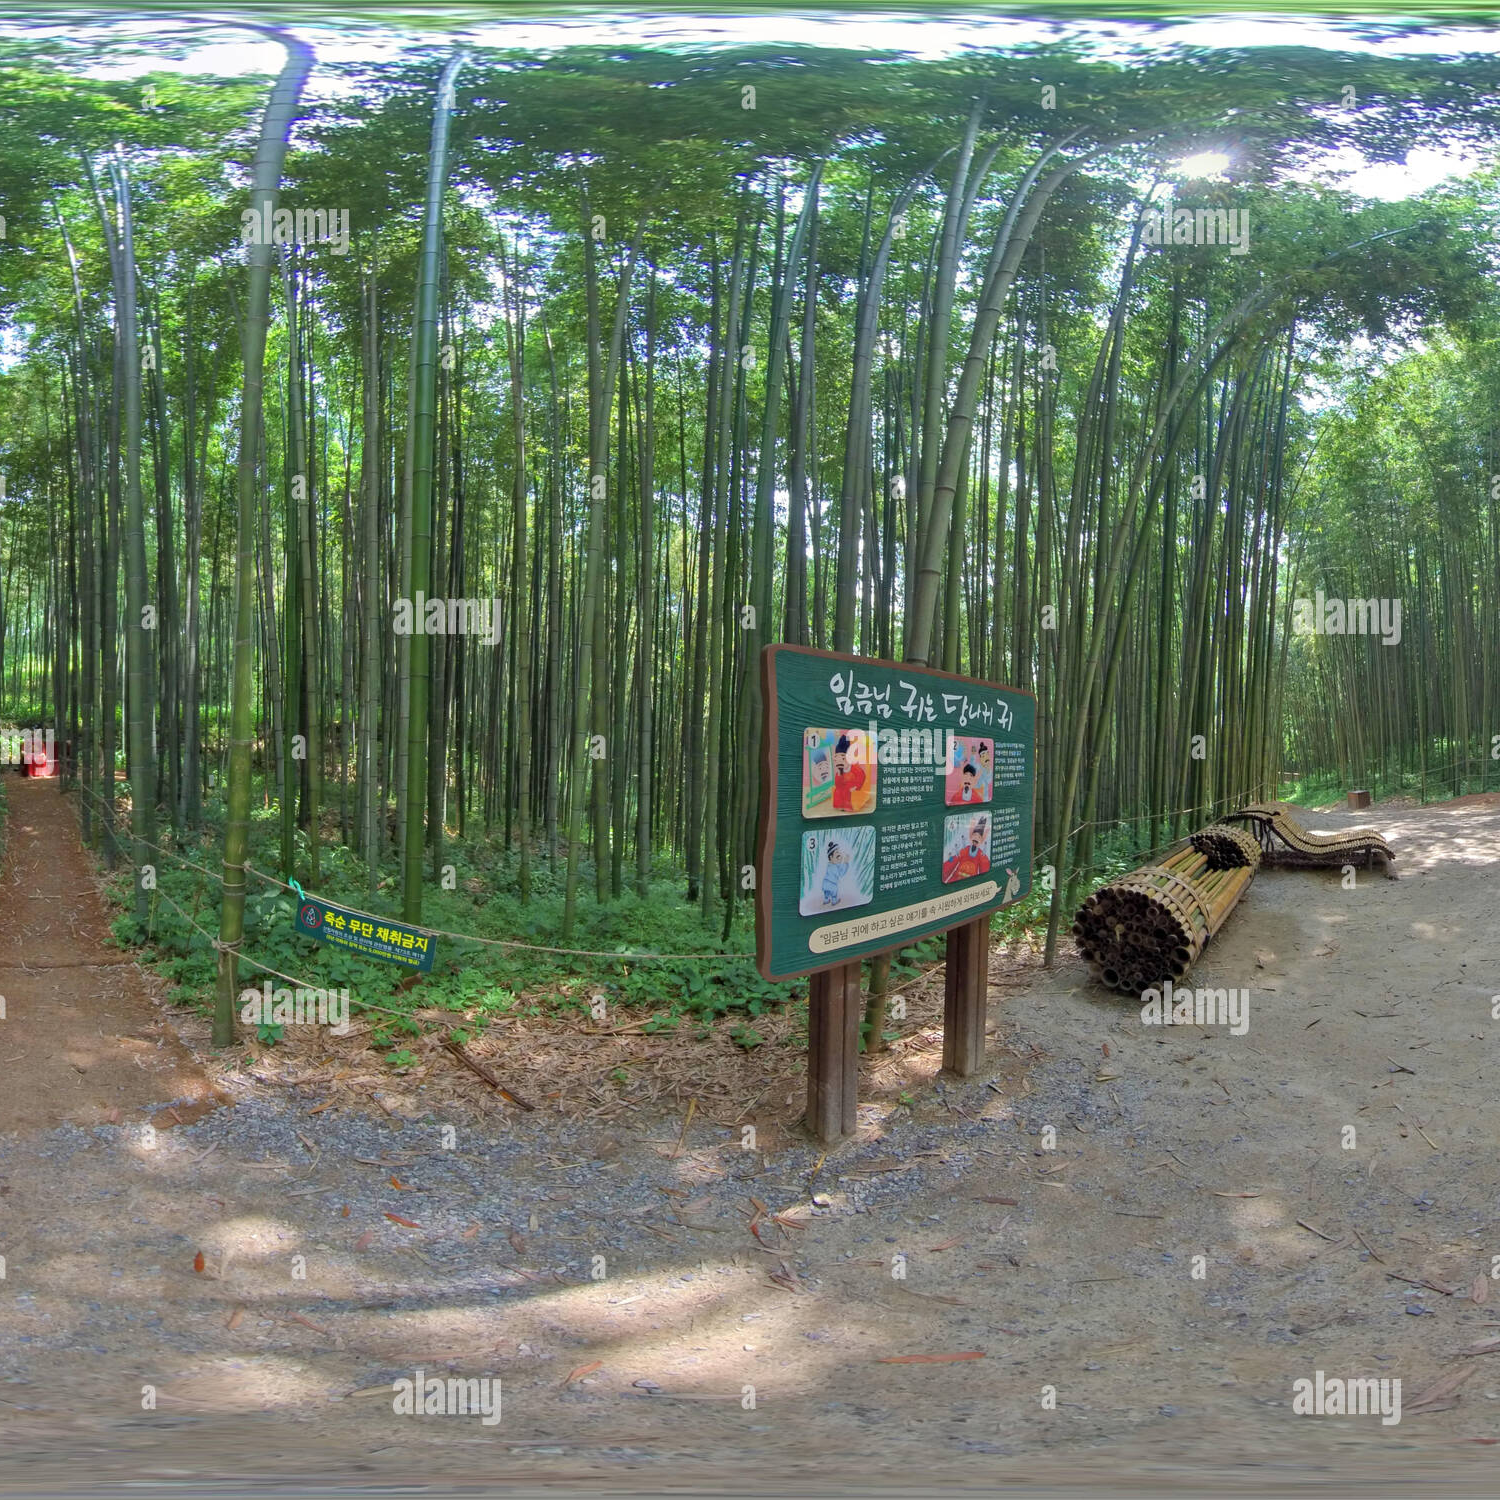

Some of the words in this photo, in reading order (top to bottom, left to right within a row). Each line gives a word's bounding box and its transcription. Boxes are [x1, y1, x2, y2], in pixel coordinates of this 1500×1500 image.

[830, 670, 891, 718] 임금님
[900, 680, 938, 721] 귀는
[944, 694, 993, 727] 당나귀
[997, 699, 1013, 732] 귀
[812, 736, 816, 747] 1
[809, 839, 815, 849] 3
[324, 911, 346, 930] 죽순
[348, 919, 373, 938] 무단
[377, 926, 428, 952] 채취금지
[851, 926, 869, 937] 귀에
[870, 920, 887, 932] 하고
[889, 917, 904, 927] 싶은
[906, 908, 928, 922] 얘기를
[937, 896, 962, 912] 시원하게
